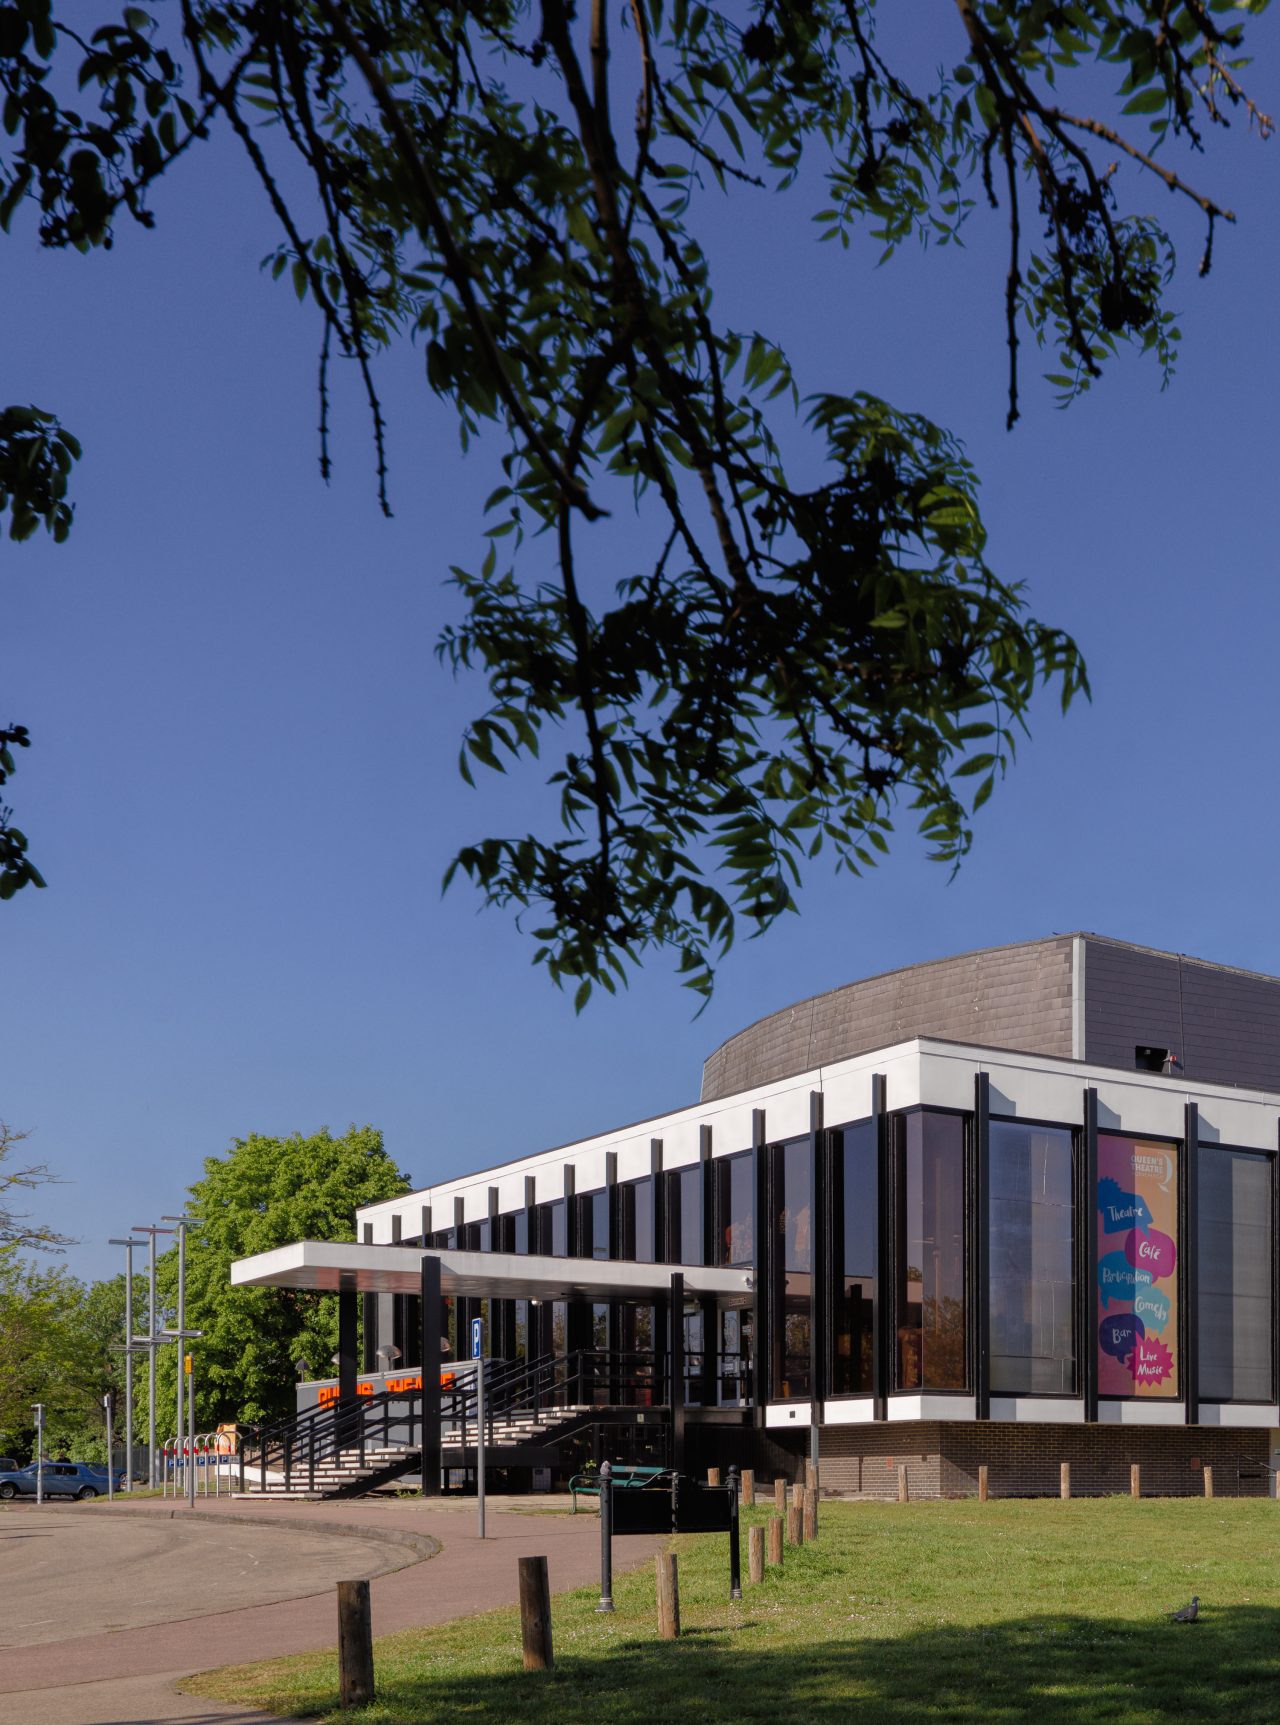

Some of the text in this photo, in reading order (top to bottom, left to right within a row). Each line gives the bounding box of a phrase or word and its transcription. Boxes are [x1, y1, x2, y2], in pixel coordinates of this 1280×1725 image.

[1107, 1205, 1143, 1222] Theatre
[1102, 1266, 1151, 1285] Participation
[1135, 1296, 1167, 1320] Comedy
[474, 1323, 480, 1355] P
[1112, 1328, 1132, 1344] Bar
[1140, 1345, 1157, 1361] Live
[1137, 1363, 1163, 1375] Music
